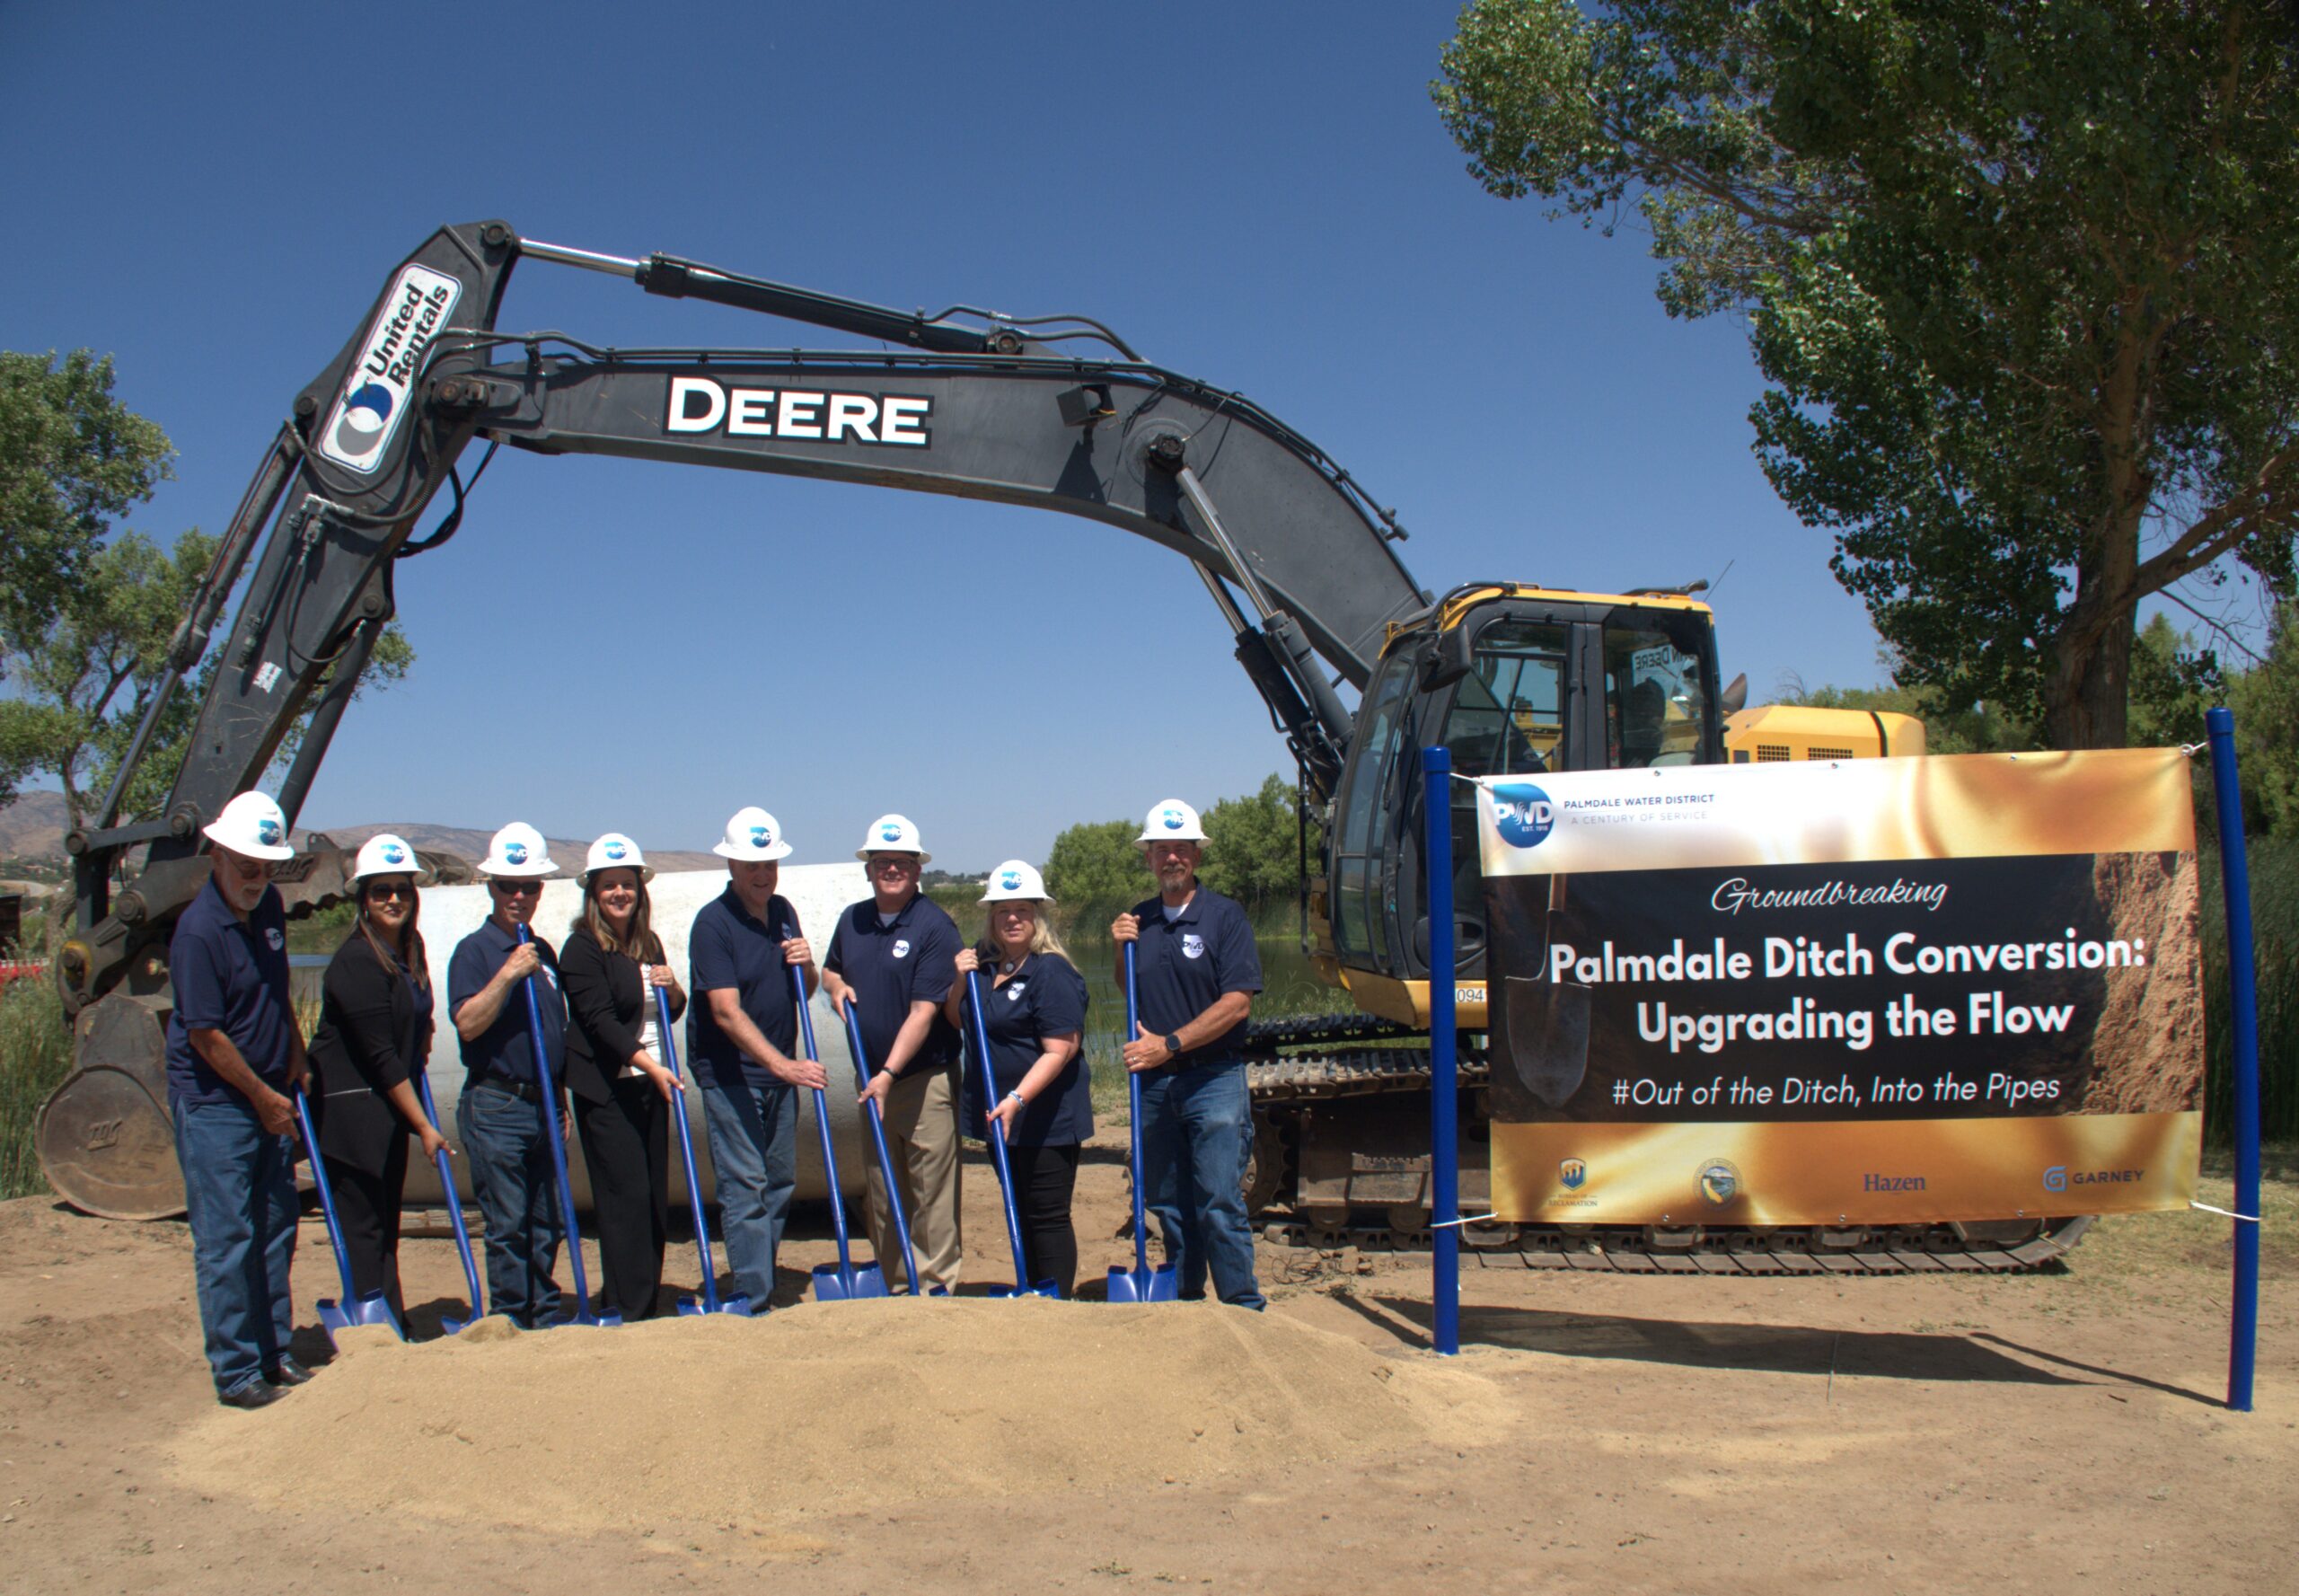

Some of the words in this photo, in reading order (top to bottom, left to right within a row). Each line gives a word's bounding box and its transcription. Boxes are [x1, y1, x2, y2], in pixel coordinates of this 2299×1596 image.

[366, 282, 424, 377] United
[387, 285, 449, 388] Rentals
[666, 375, 931, 446] DEERE
[1494, 800, 1555, 826] PWD
[1563, 798, 1621, 809] PALMDALE
[1625, 796, 1661, 807] WATER
[1665, 794, 1715, 805] DISTRICT
[1571, 816, 1579, 825] A
[1582, 814, 1635, 825] CENTURY
[1640, 813, 1655, 822] OF
[1660, 811, 1708, 821] SERVICE
[1712, 877, 1948, 915] Groundbreaking
[1550, 937, 1752, 983] Palmdale
[1765, 932, 1874, 978] Ditch
[1884, 927, 2145, 974] Conversion:
[1637, 997, 1873, 1054] Upgrading
[1886, 993, 1957, 1037] the
[1969, 991, 2074, 1035] Flow
[1613, 1078, 1684, 1106] #Out
[1692, 1076, 1723, 1106] of
[1730, 1076, 1774, 1106] the
[1782, 1074, 1862, 1107] Ditch,
[1872, 1076, 1924, 1103] Into
[1933, 1071, 1978, 1102] the
[1986, 1072, 2061, 1108] Pipes
[1863, 1174, 1926, 1193] Hazen
[2073, 1170, 2145, 1185] GARNEY
